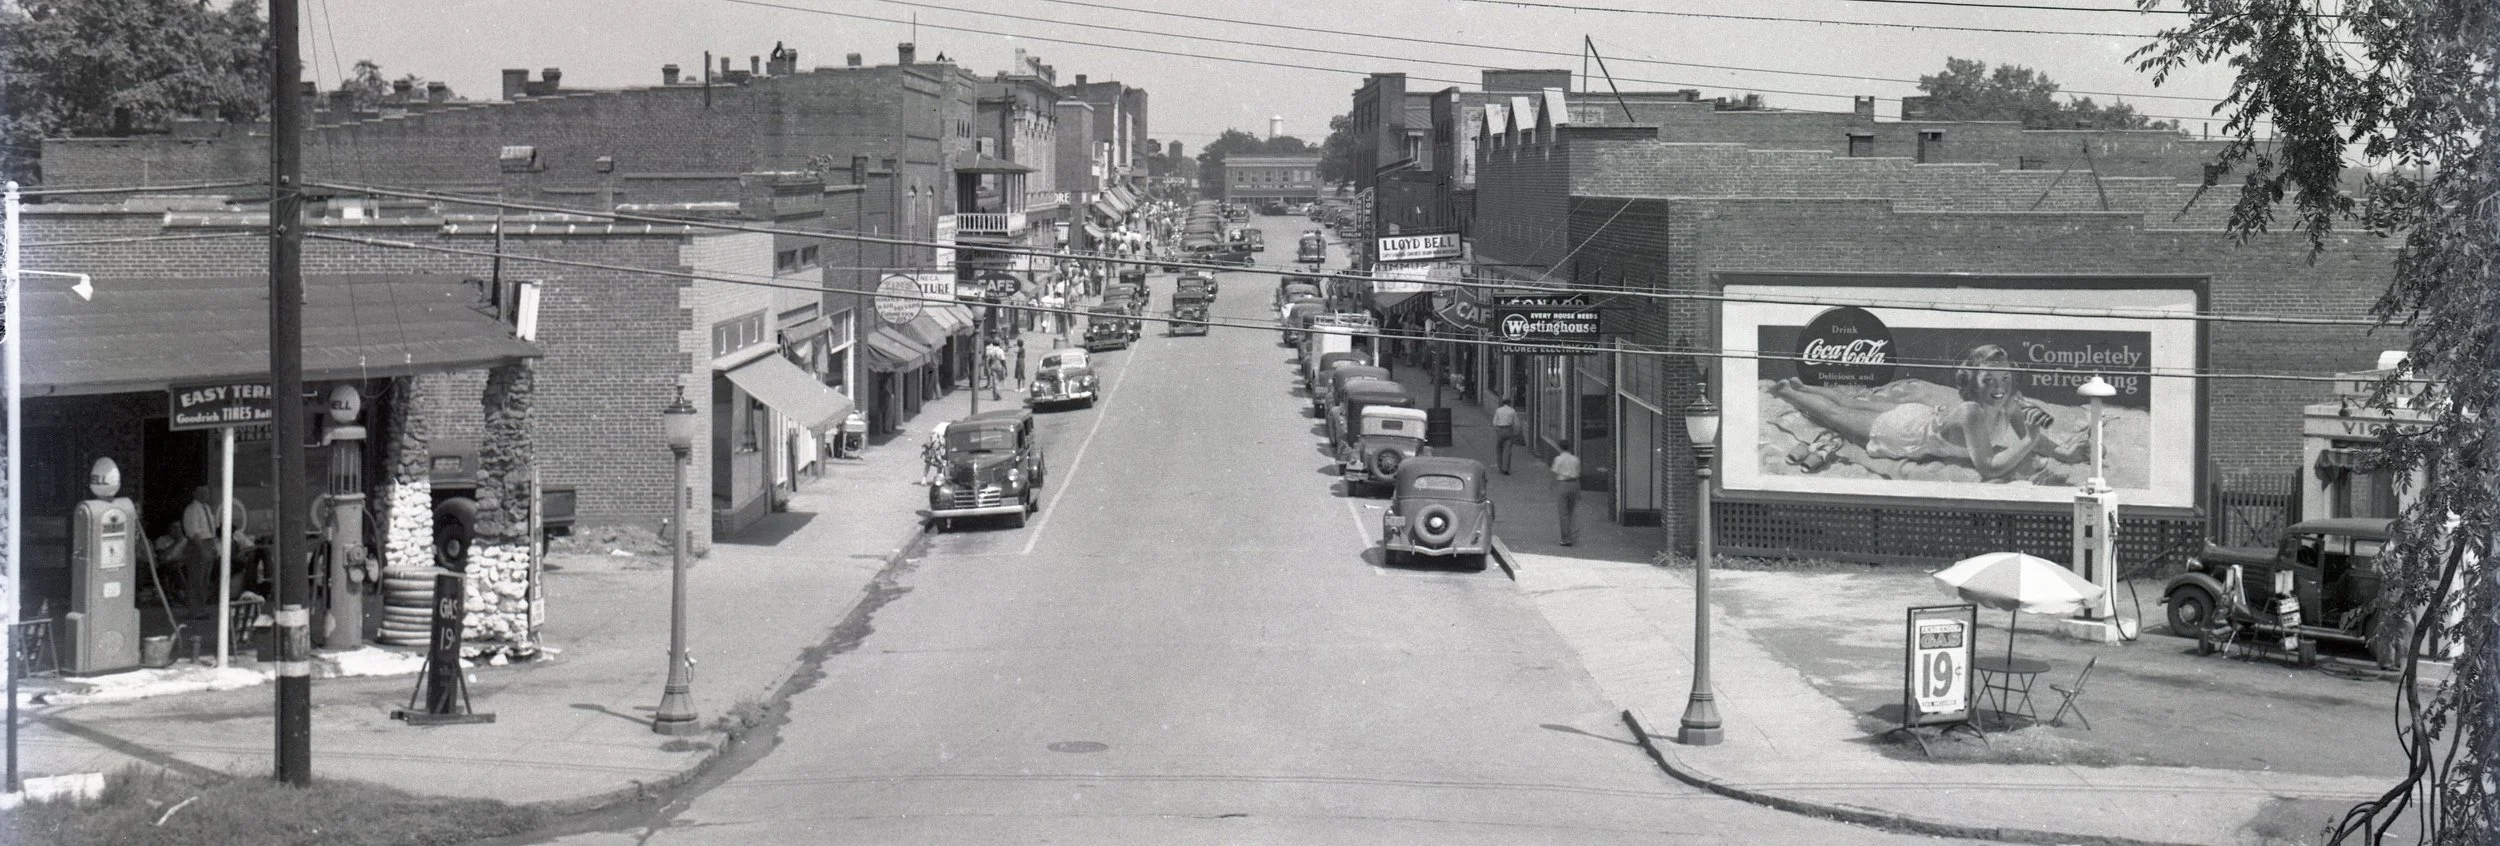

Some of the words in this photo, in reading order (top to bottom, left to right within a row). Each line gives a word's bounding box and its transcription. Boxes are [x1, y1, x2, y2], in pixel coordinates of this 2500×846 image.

[1383, 238, 1420, 251] LLOYD
[1424, 236, 1455, 249] BELL
[922, 283, 950, 294] TURE
[1456, 301, 1492, 324] CAF
[1530, 312, 1551, 320] EVERY
[1553, 312, 1575, 320] HOUSE
[1577, 312, 1598, 320] NEEDS
[1506, 320, 1597, 336] Westinghouse
[1832, 325, 1858, 334] Drink
[1803, 338, 1889, 365] Coca-Cola
[1818, 372, 1856, 380] Delicious
[2031, 367, 2138, 395] refresing
[2353, 380, 2414, 395] TAK
[180, 385, 228, 408] EASY
[331, 400, 352, 411] ELL
[176, 411, 220, 424] Goodrich
[222, 406, 252, 420] TIRES
[440, 598, 458, 619] GAS
[1921, 632, 1961, 648] GAS
